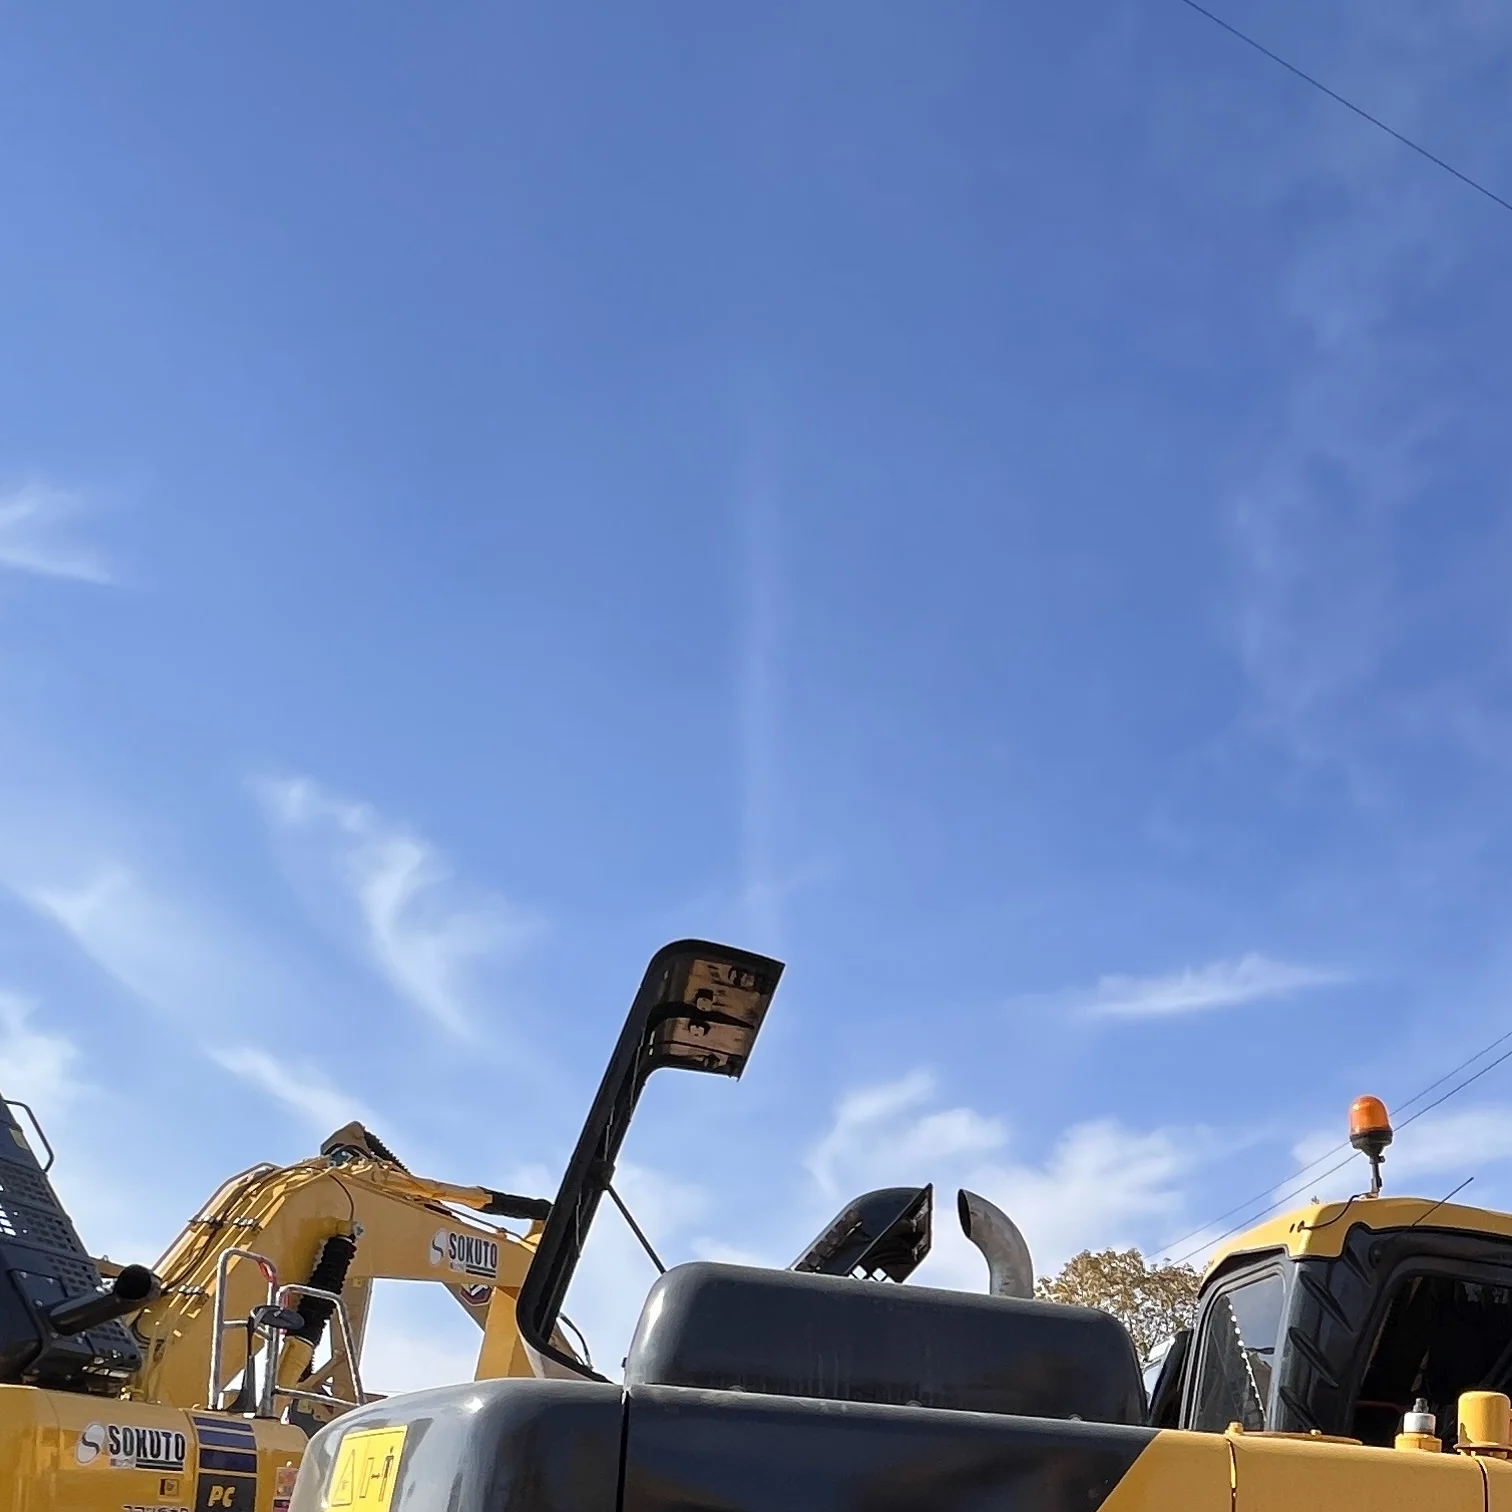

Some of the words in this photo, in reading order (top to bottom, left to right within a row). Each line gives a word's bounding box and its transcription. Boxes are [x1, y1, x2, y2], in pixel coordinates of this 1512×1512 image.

[448, 1232, 498, 1269] SOKUTO
[107, 1424, 186, 1461] SOKUTO
[207, 1485, 236, 1508] PC
